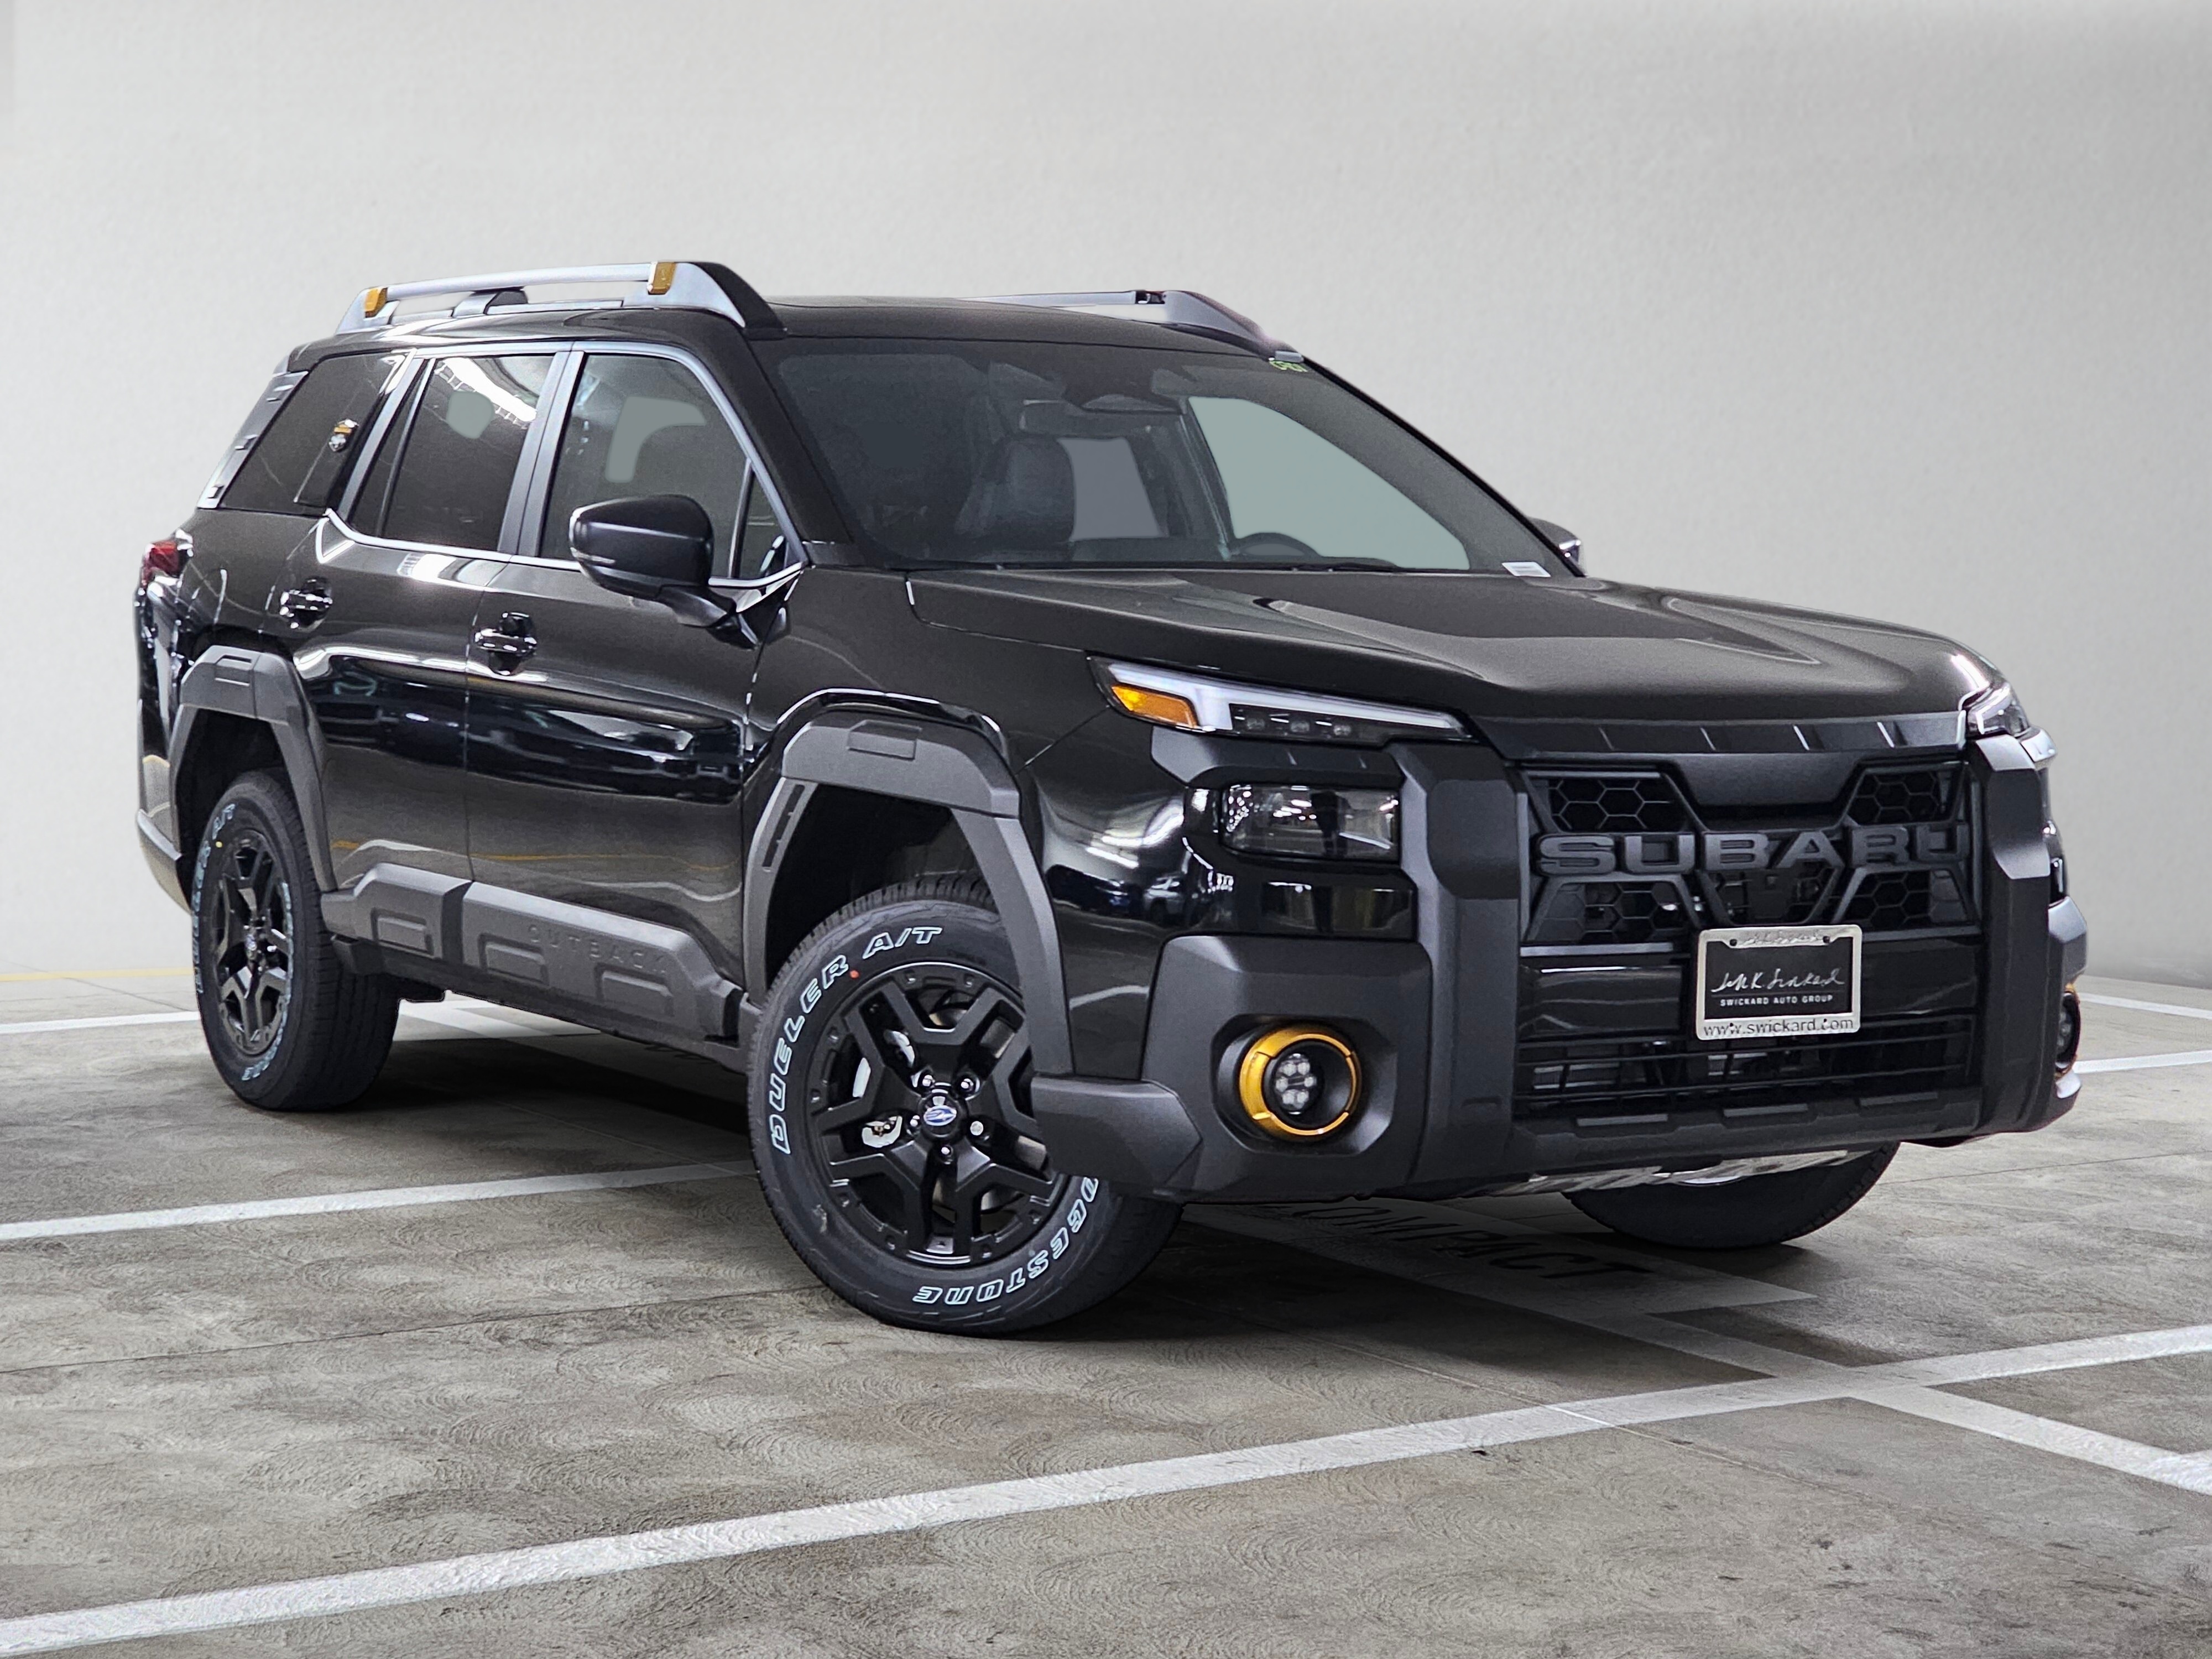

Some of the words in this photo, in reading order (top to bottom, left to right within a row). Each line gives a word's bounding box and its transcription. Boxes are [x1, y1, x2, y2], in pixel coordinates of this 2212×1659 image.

[1539, 824, 1970, 875] SUBARU
[1703, 1018, 1853, 1036] www.swickard.com
[1720, 997, 1769, 1007] SWICKARD
[1773, 996, 1798, 1004] AUTO
[1802, 994, 1833, 1003] GROUP
[769, 954, 849, 1154] DUELER
[862, 926, 942, 959] A/T
[912, 1177, 1099, 1305] DGESTONE
[1258, 1205, 1655, 1279] OMPACT
